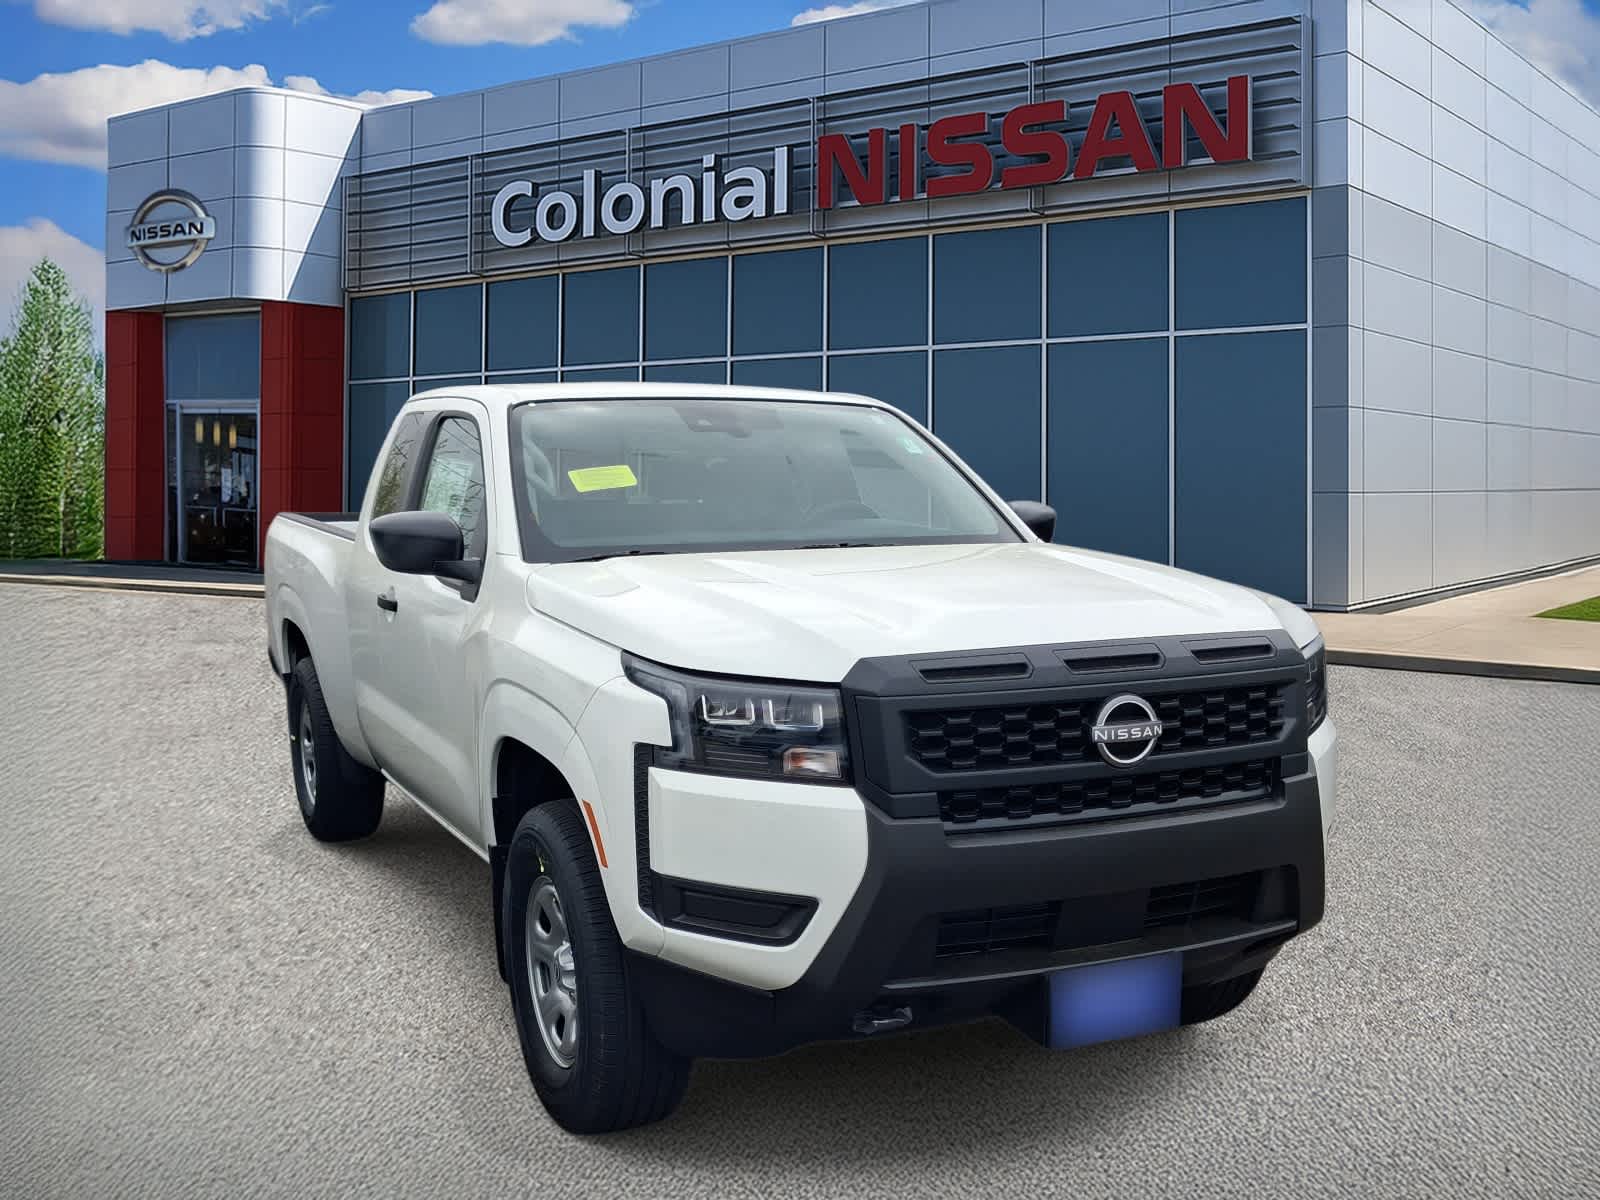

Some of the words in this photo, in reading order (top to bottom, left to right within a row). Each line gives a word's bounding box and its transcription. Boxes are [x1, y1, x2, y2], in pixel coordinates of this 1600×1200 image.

[491, 146, 790, 247] Colonial
[817, 74, 1252, 209] NISSAN
[129, 221, 204, 243] NISSAN
[1094, 724, 1162, 741] NISSAN
